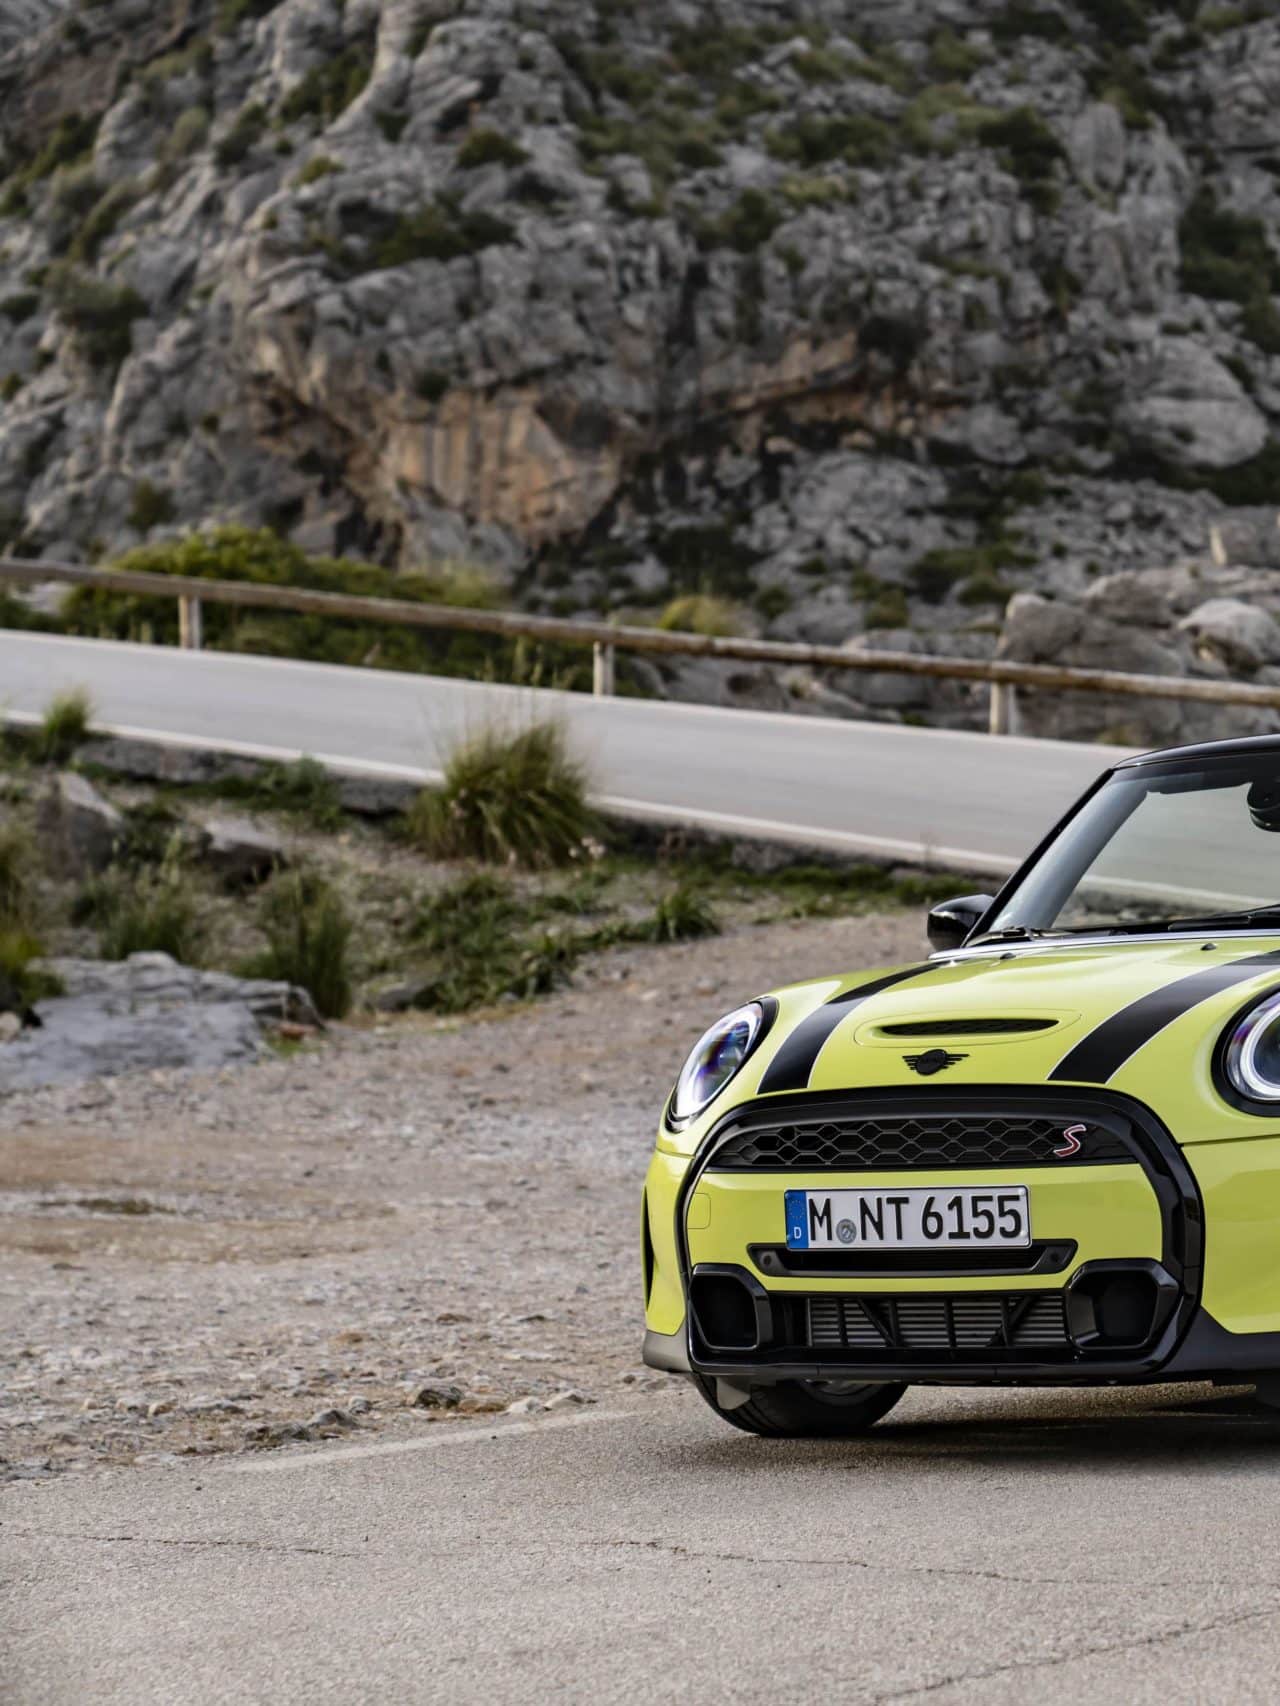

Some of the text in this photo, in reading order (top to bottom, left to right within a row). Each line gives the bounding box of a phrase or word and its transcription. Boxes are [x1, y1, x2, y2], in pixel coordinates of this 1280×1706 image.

[1053, 1124, 1086, 1157] S
[794, 1226, 802, 1239] D
[809, 1195, 1022, 1240] M NT 6155
